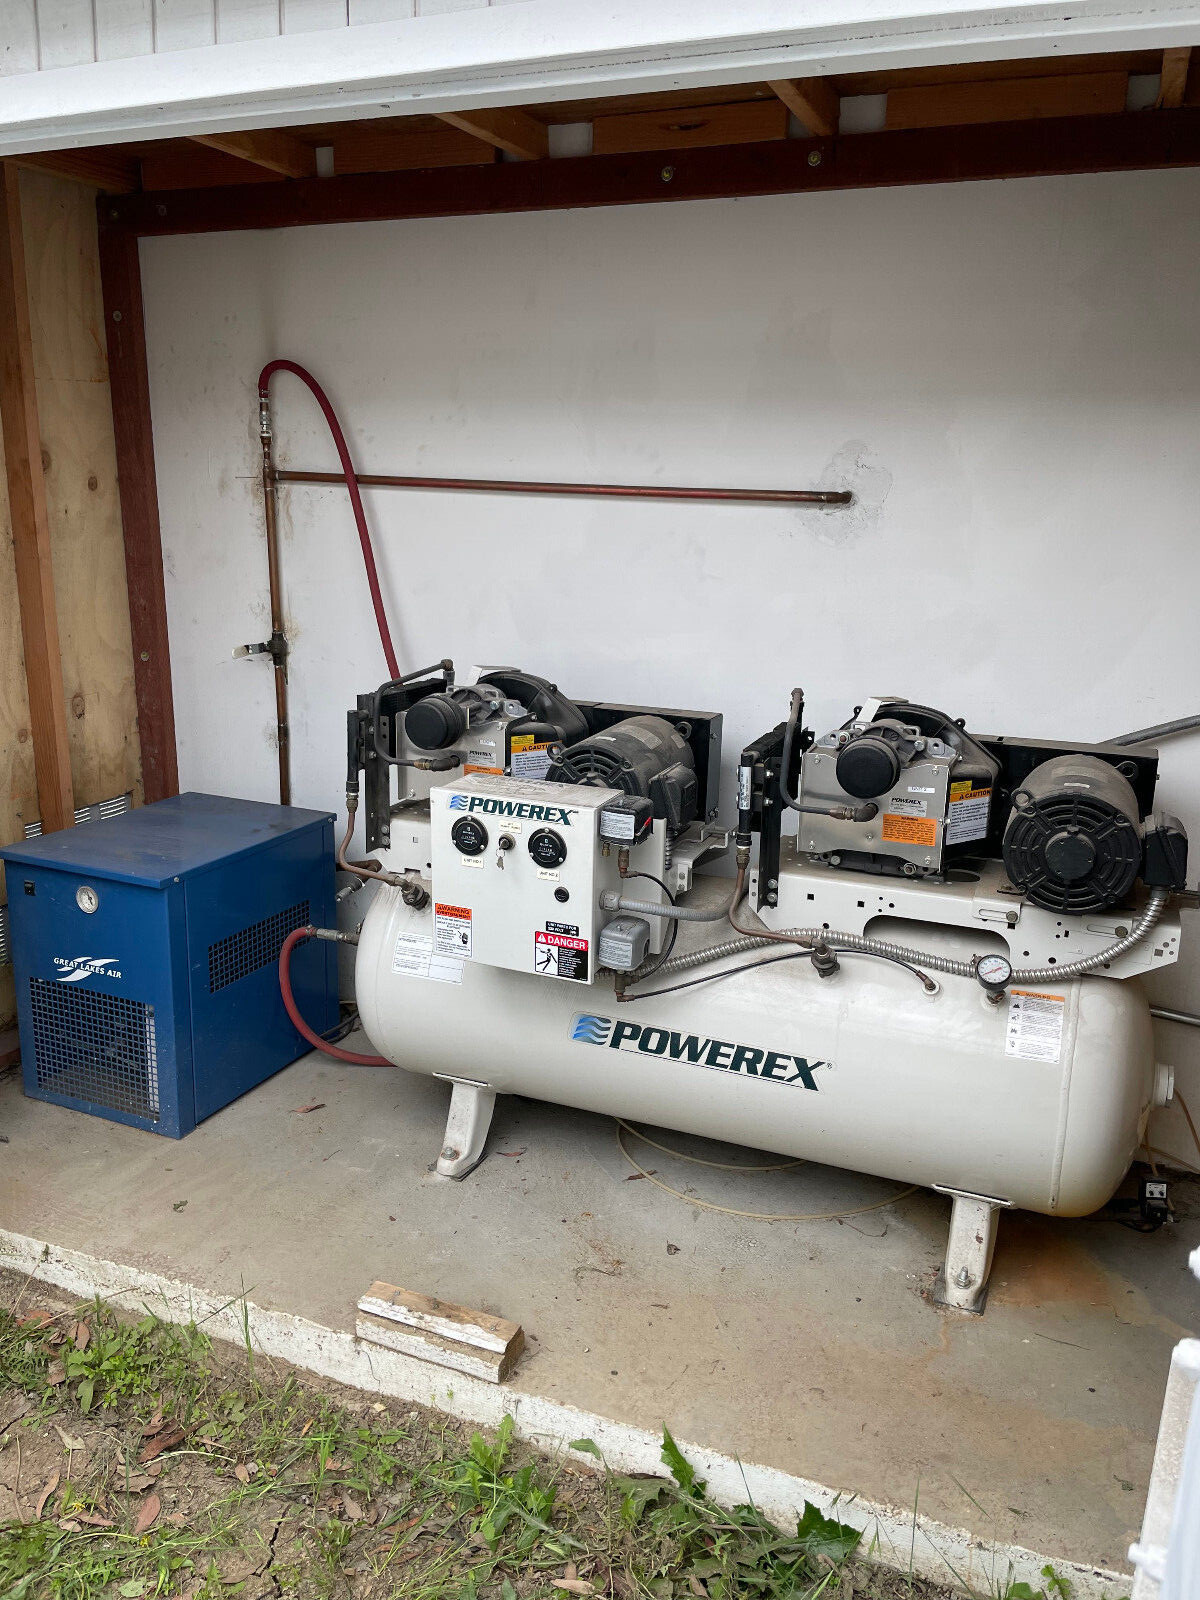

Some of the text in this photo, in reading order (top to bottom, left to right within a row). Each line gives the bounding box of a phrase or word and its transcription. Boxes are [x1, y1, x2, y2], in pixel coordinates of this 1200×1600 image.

[891, 797, 922, 806] POWEREX
[965, 788, 991, 800] CAUTION
[468, 796, 574, 826] POWEREX
[547, 935, 586, 950] DANGER
[53, 957, 122, 979] GREAT LAKES AIR
[608, 1020, 826, 1092] POWEREX
